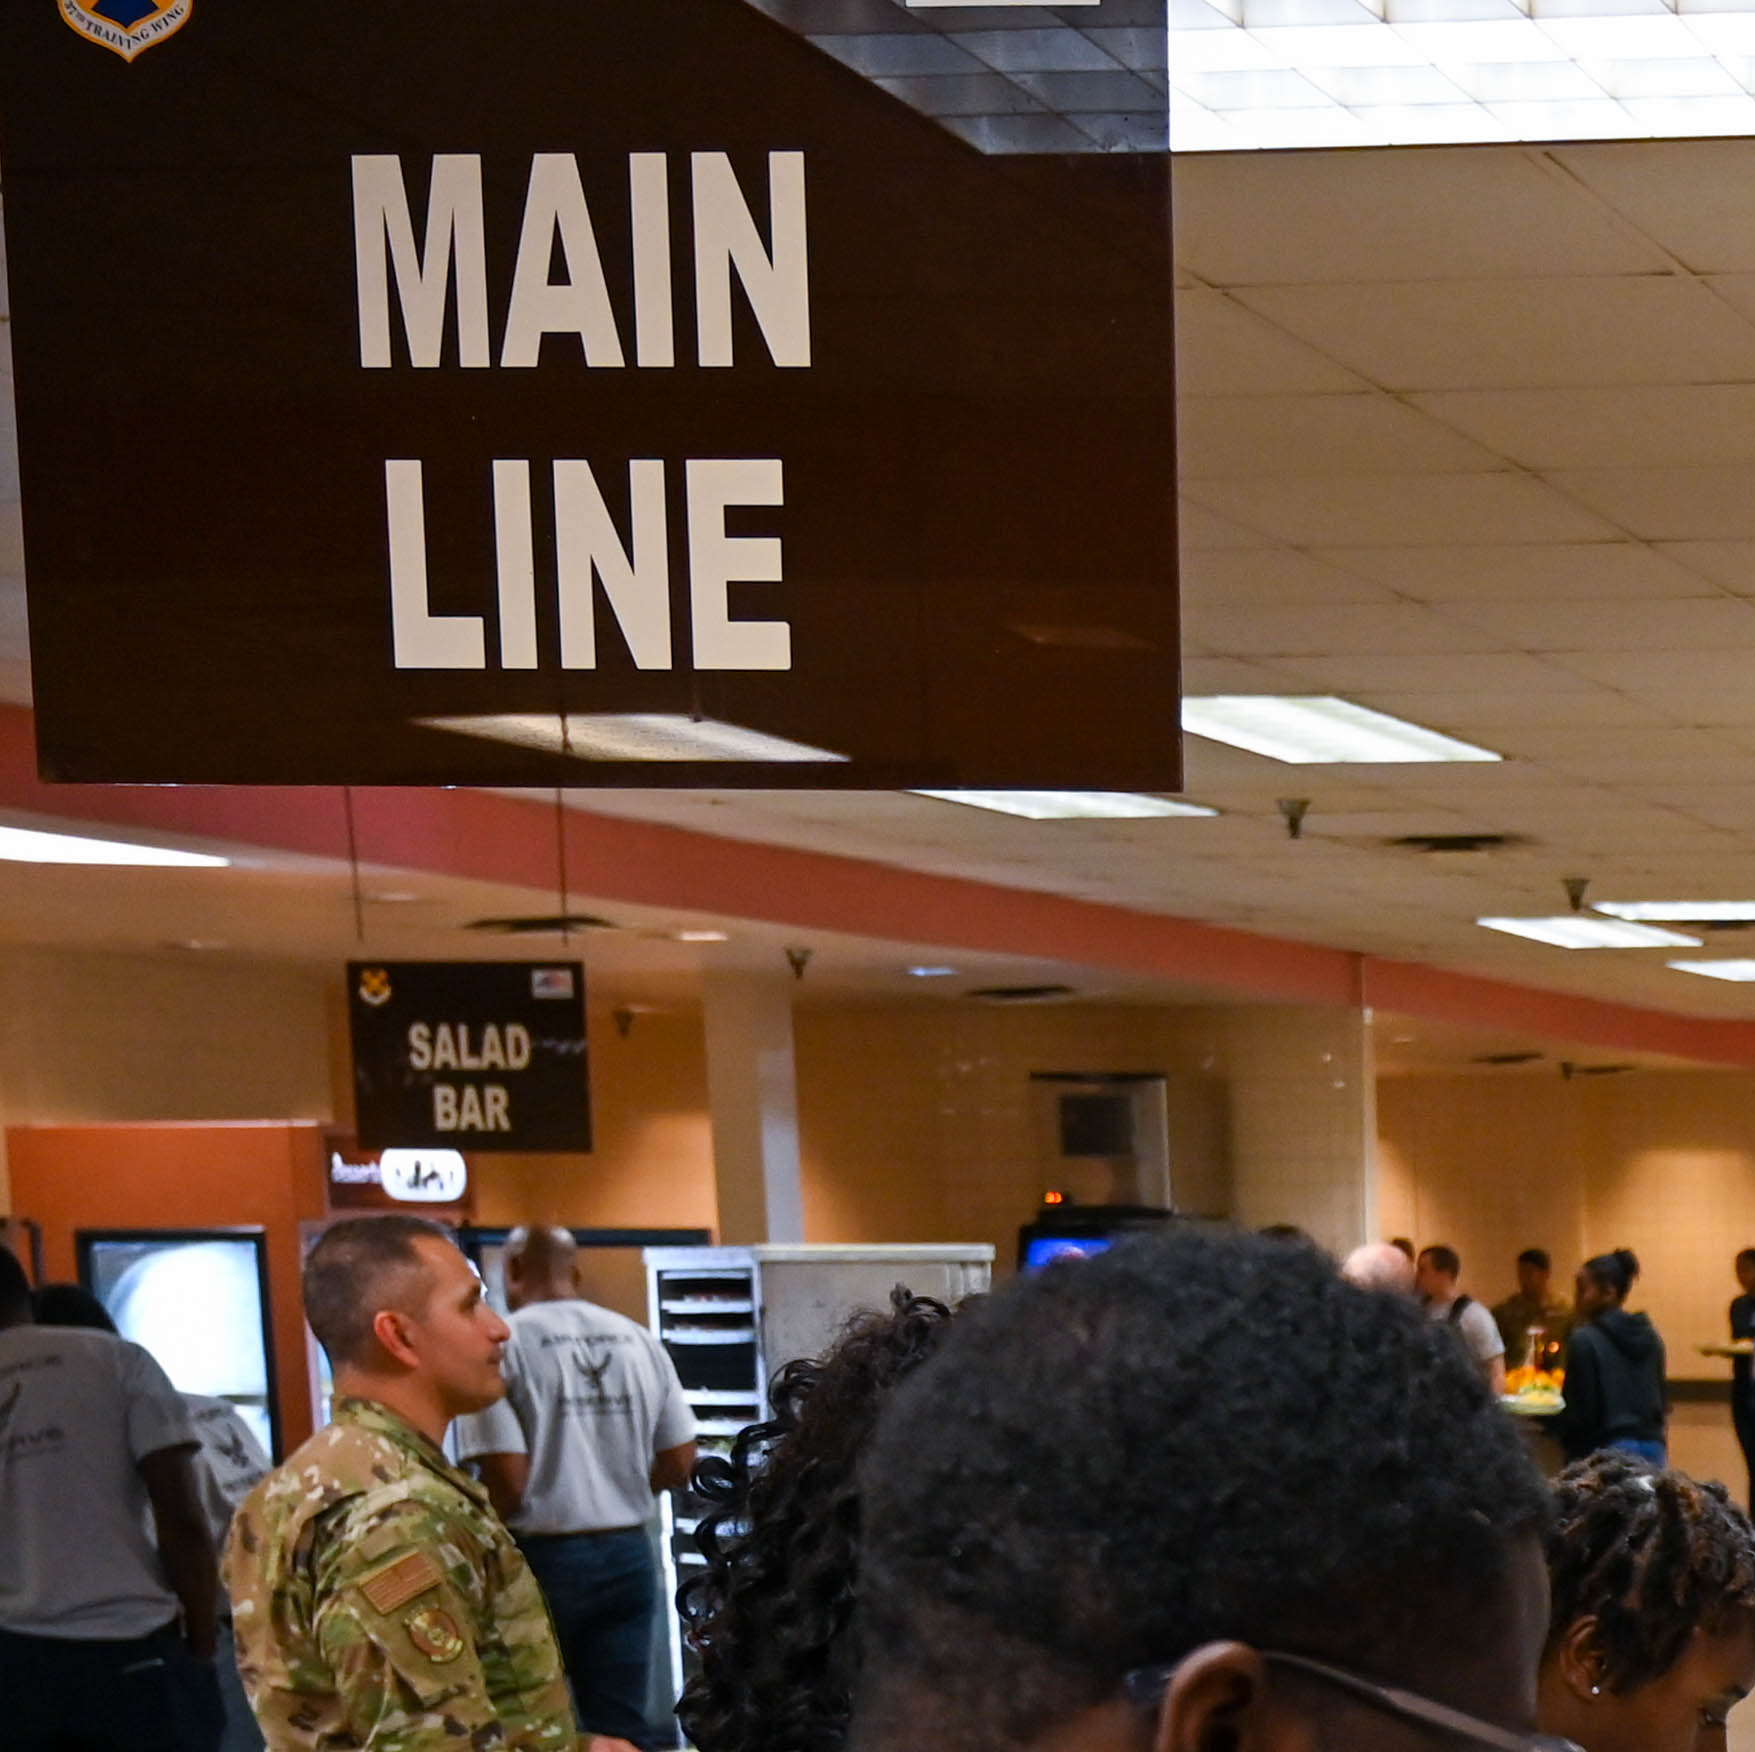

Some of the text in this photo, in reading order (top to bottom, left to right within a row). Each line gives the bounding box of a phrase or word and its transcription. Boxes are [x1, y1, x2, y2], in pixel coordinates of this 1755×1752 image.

[85, 19, 150, 50] TRAINING
[151, 4, 185, 33] WING
[351, 151, 811, 368] MAIN
[385, 459, 791, 670] LINE
[408, 1022, 531, 1070] SALAD
[433, 1084, 511, 1131] BAR
